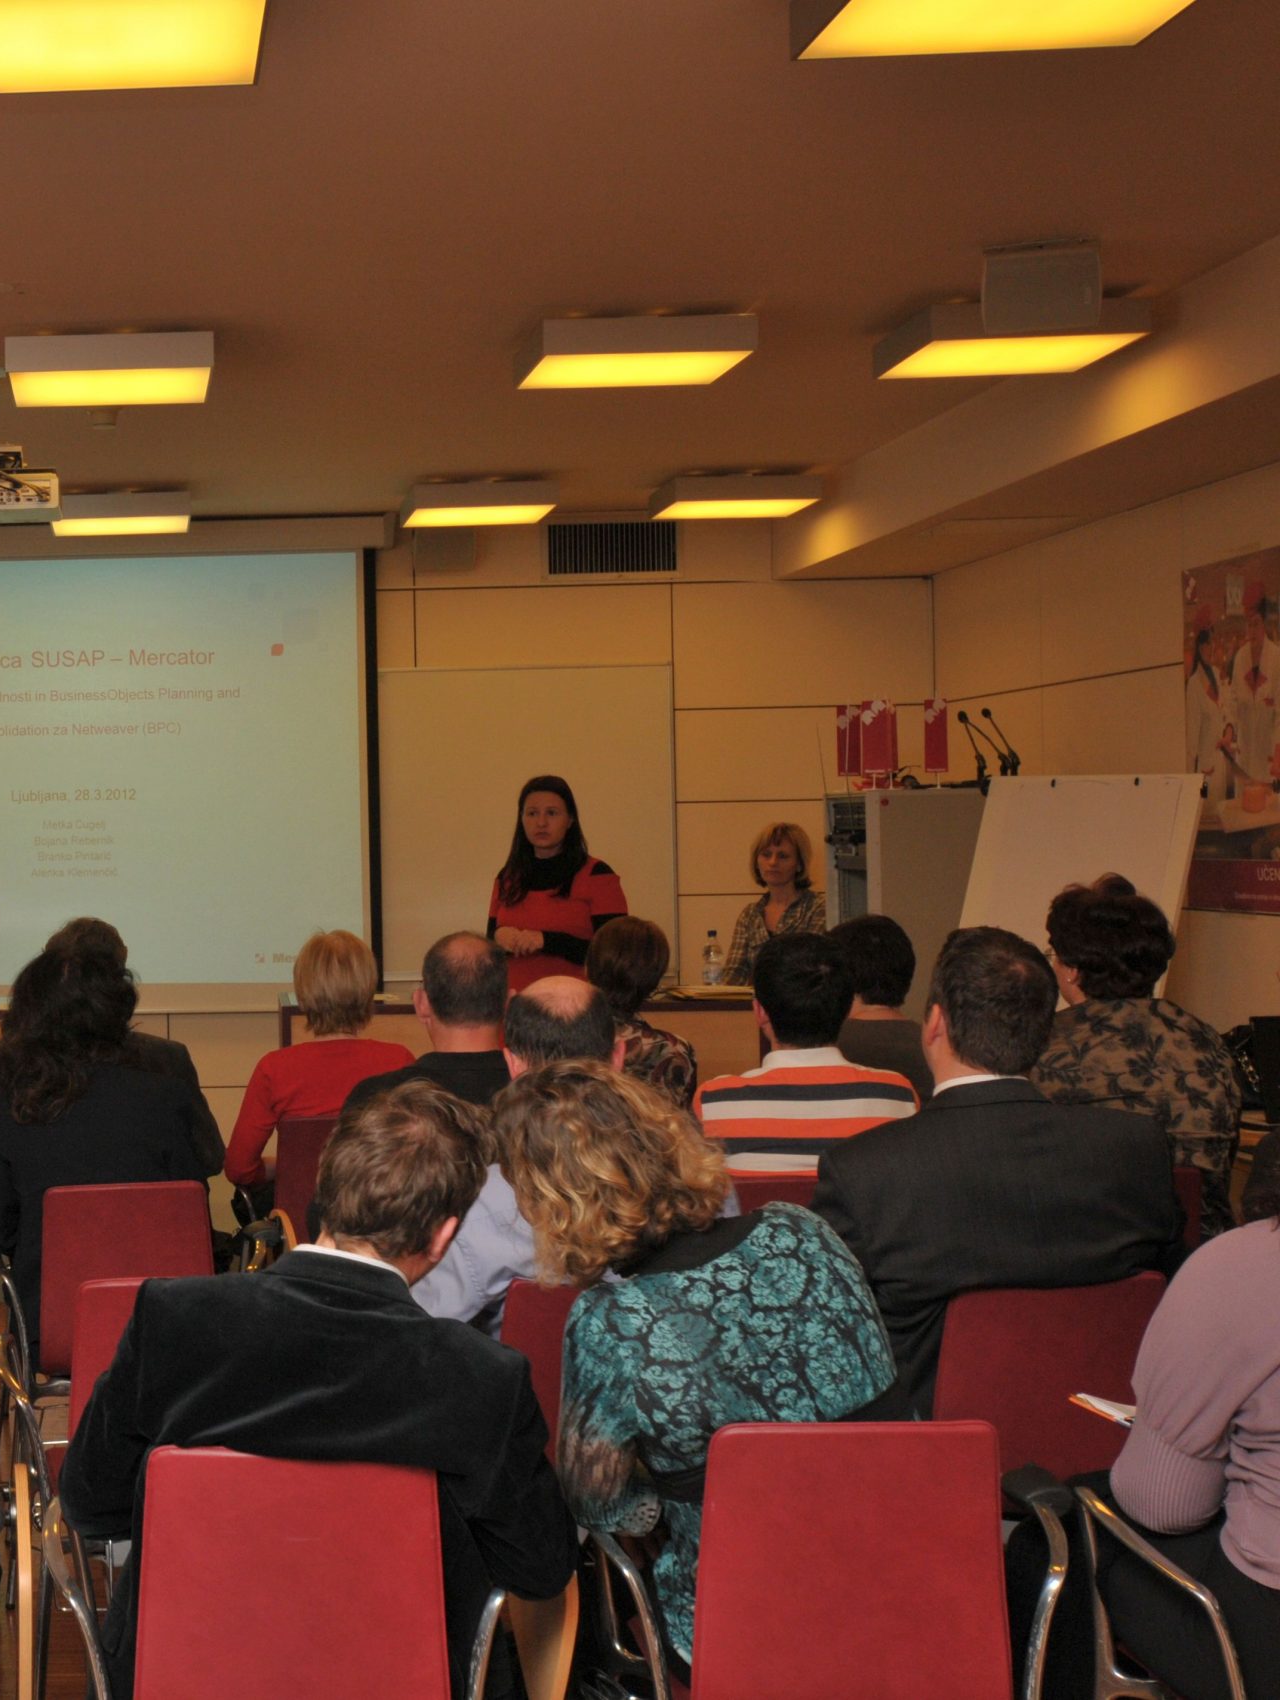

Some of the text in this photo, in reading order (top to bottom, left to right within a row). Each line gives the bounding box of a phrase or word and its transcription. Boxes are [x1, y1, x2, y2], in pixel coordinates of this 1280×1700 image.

[31, 650, 105, 668] SUSAP
[129, 648, 216, 666] Mercator
[35, 690, 46, 702] in
[158, 687, 213, 702] Planning
[217, 686, 241, 699] and
[54, 726, 68, 736] za
[71, 723, 139, 736] Netweaver
[143, 721, 182, 737] (BPC)
[74, 787, 137, 801] 28.3.2012
